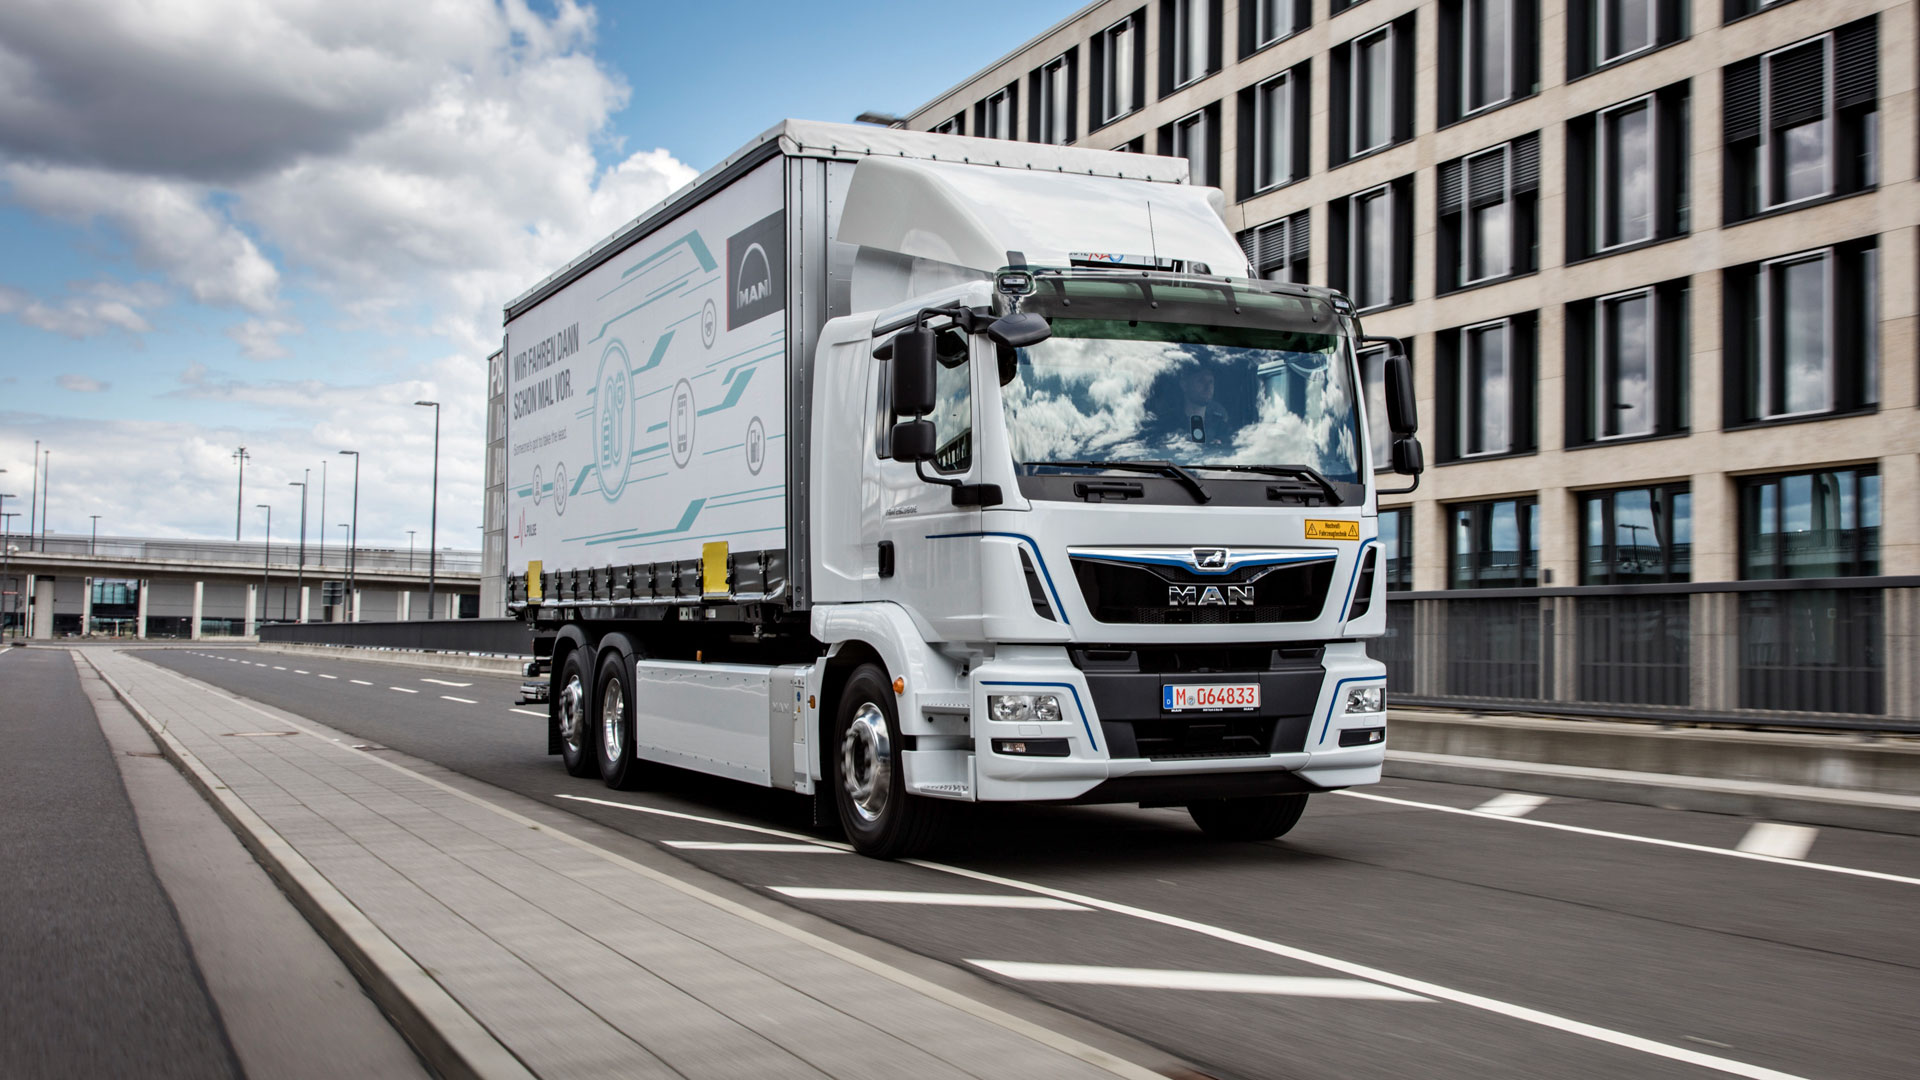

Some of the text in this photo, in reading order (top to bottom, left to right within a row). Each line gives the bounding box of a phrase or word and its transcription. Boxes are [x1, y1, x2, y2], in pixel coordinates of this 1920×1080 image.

[739, 279, 769, 307] MAN
[513, 321, 579, 383] WIR FAHREN DANN
[513, 368, 574, 421] SCHON MAL VOR.
[1168, 586, 1255, 606] MAN
[1176, 688, 1186, 705] M
[1197, 687, 1255, 705] 064833
